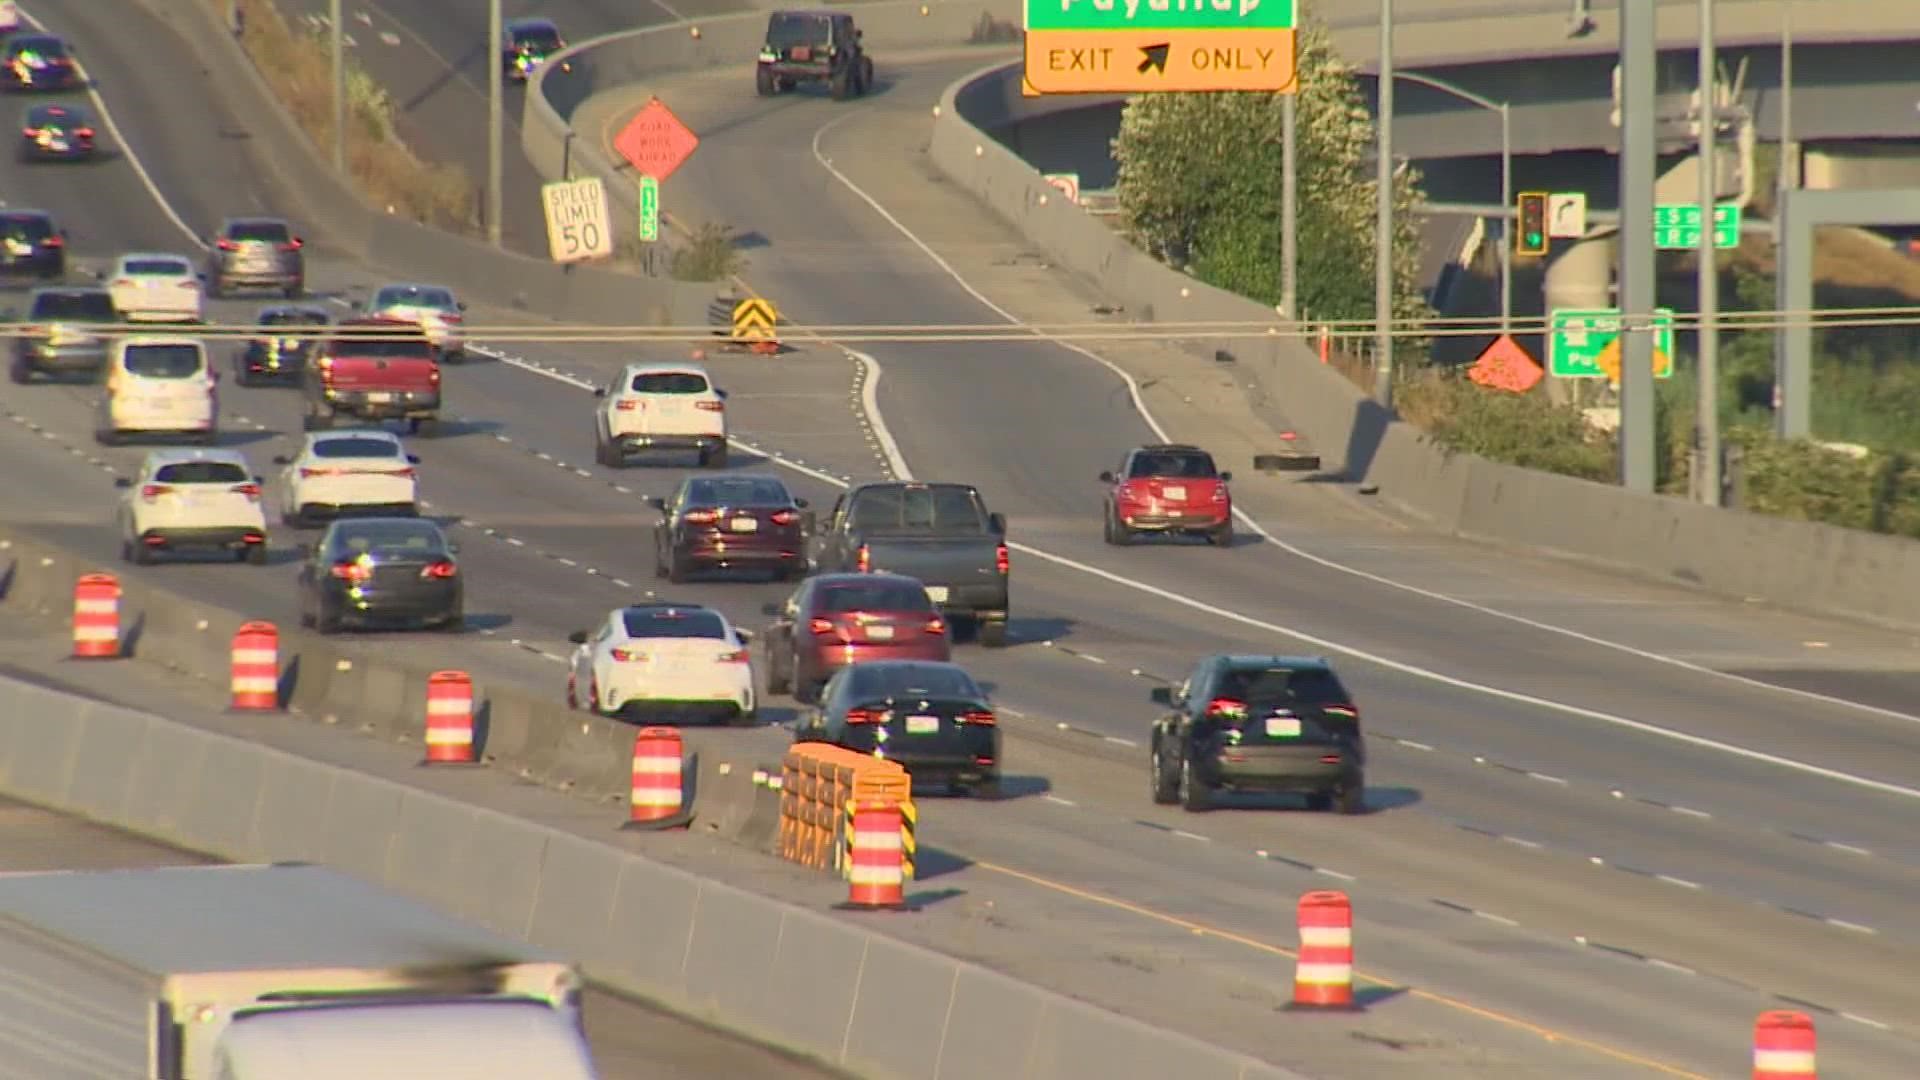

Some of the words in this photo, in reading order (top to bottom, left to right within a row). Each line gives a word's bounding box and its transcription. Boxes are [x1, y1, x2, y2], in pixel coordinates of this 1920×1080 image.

[1048, 47, 1113, 71] EXIT
[1191, 47, 1274, 71] ONLY
[550, 184, 599, 206] SPEED
[554, 203, 600, 225] LIMIT
[562, 222, 599, 254] 50
